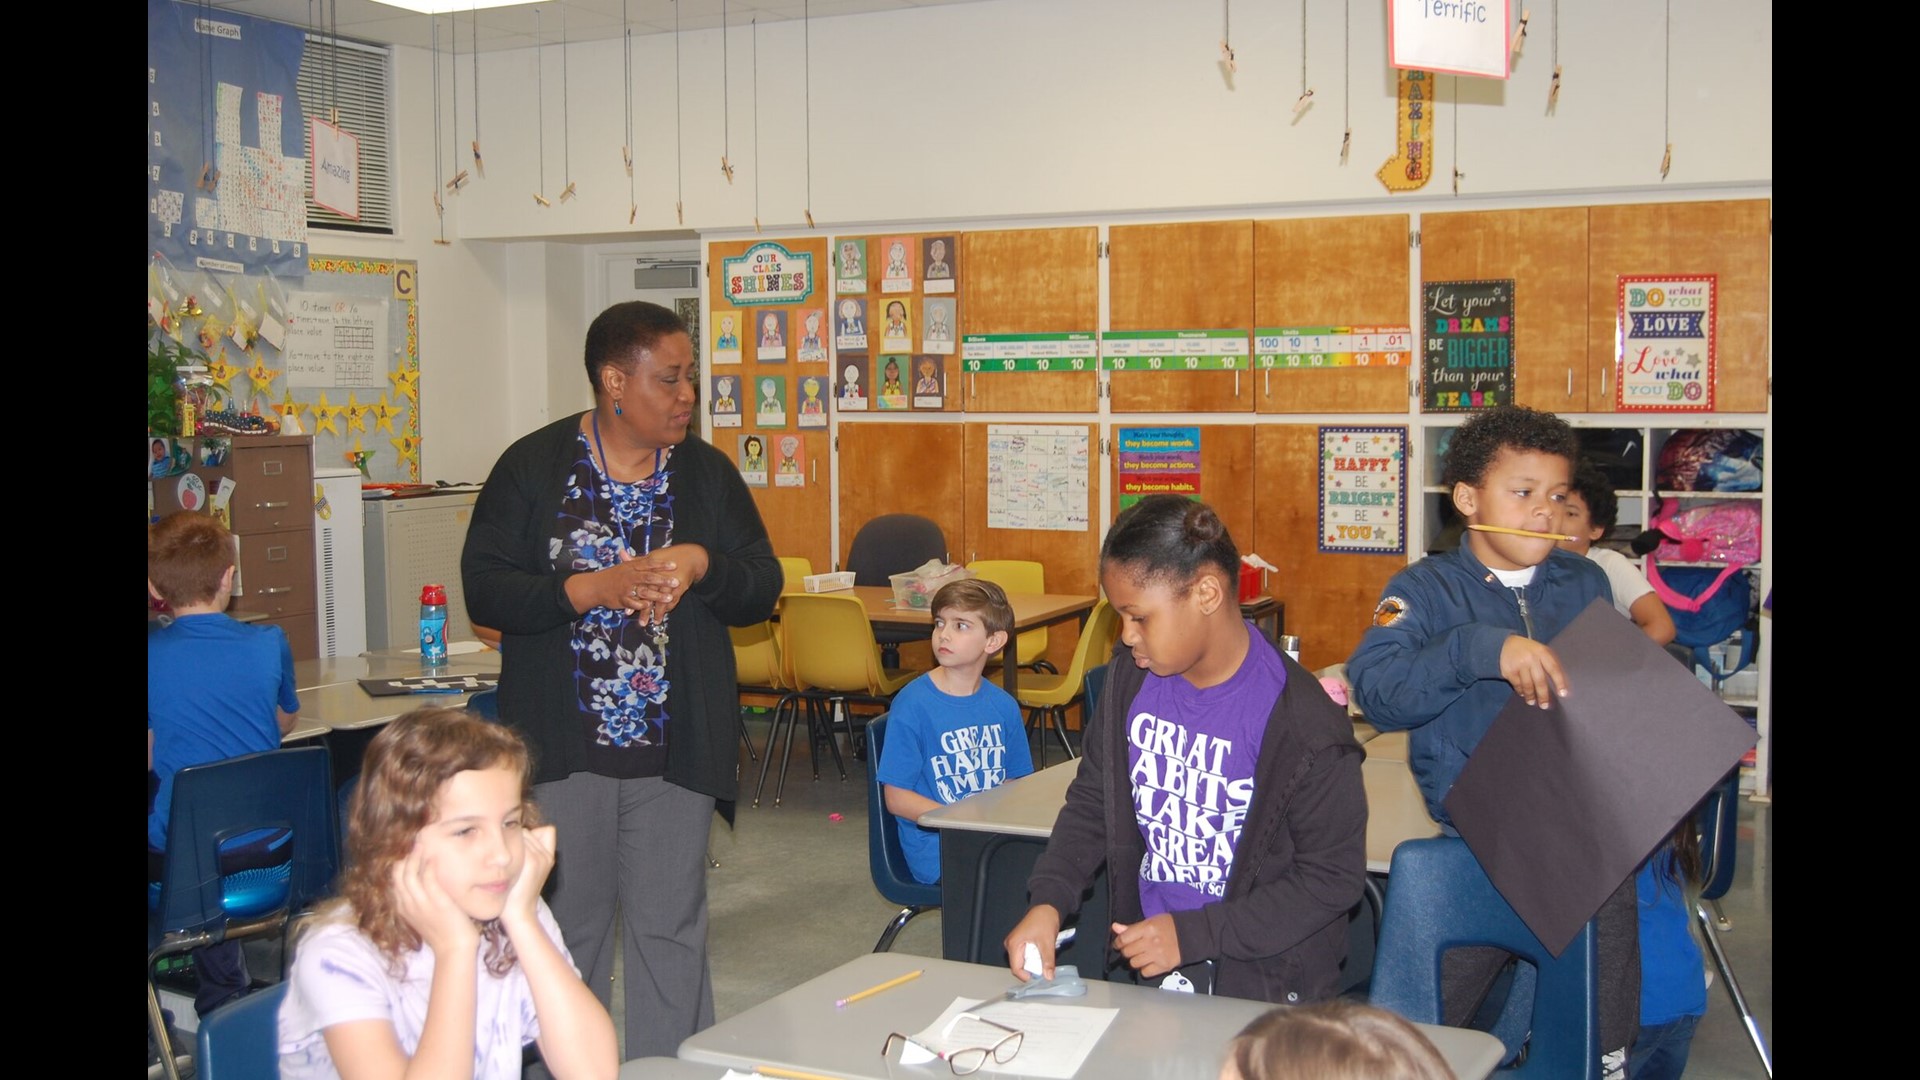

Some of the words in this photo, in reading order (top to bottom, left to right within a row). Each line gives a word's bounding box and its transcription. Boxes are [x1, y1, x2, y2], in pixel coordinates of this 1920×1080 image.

[217, 26, 239, 37] Graph
[756, 254, 776, 262] OUR
[752, 264, 782, 273] CLASS
[396, 270, 411, 294] C
[732, 272, 804, 294] SHINES
[1429, 286, 1457, 315] Let
[1463, 296, 1496, 316] your
[1630, 288, 1664, 308] DO
[1668, 286, 1702, 296] what
[1668, 298, 1702, 307] YOU
[1436, 316, 1510, 333] DREAMS
[1643, 318, 1690, 332] LOVE
[1260, 338, 1278, 348] 100
[1290, 338, 1300, 347] 10
[1314, 337, 1320, 346] 1
[1386, 335, 1402, 346] .01
[1428, 338, 1444, 351] BE
[1448, 337, 1508, 368] BIGGER
[1628, 345, 1679, 374] Love
[1432, 367, 1464, 384] than
[1471, 372, 1504, 391] your
[1656, 368, 1700, 380] what
[1629, 386, 1663, 395] YOU
[1667, 381, 1702, 400] DO
[1436, 391, 1497, 407] FEARS.
[1355, 442, 1369, 453] BE
[1124, 462, 1139, 470] they
[1333, 457, 1391, 472] HAPPY
[1126, 483, 1141, 492] they
[1355, 476, 1368, 487] BE
[1328, 491, 1396, 506] BRIGHT
[1355, 510, 1368, 521] BE
[1336, 526, 1372, 539] YOU
[940, 724, 1002, 754] GREAT
[1130, 712, 1232, 776] GREAT
[950, 768, 1006, 794] MK
[1131, 750, 1254, 812] ABITS
[1148, 821, 1242, 866] GREA
[1151, 852, 1230, 882] DER
